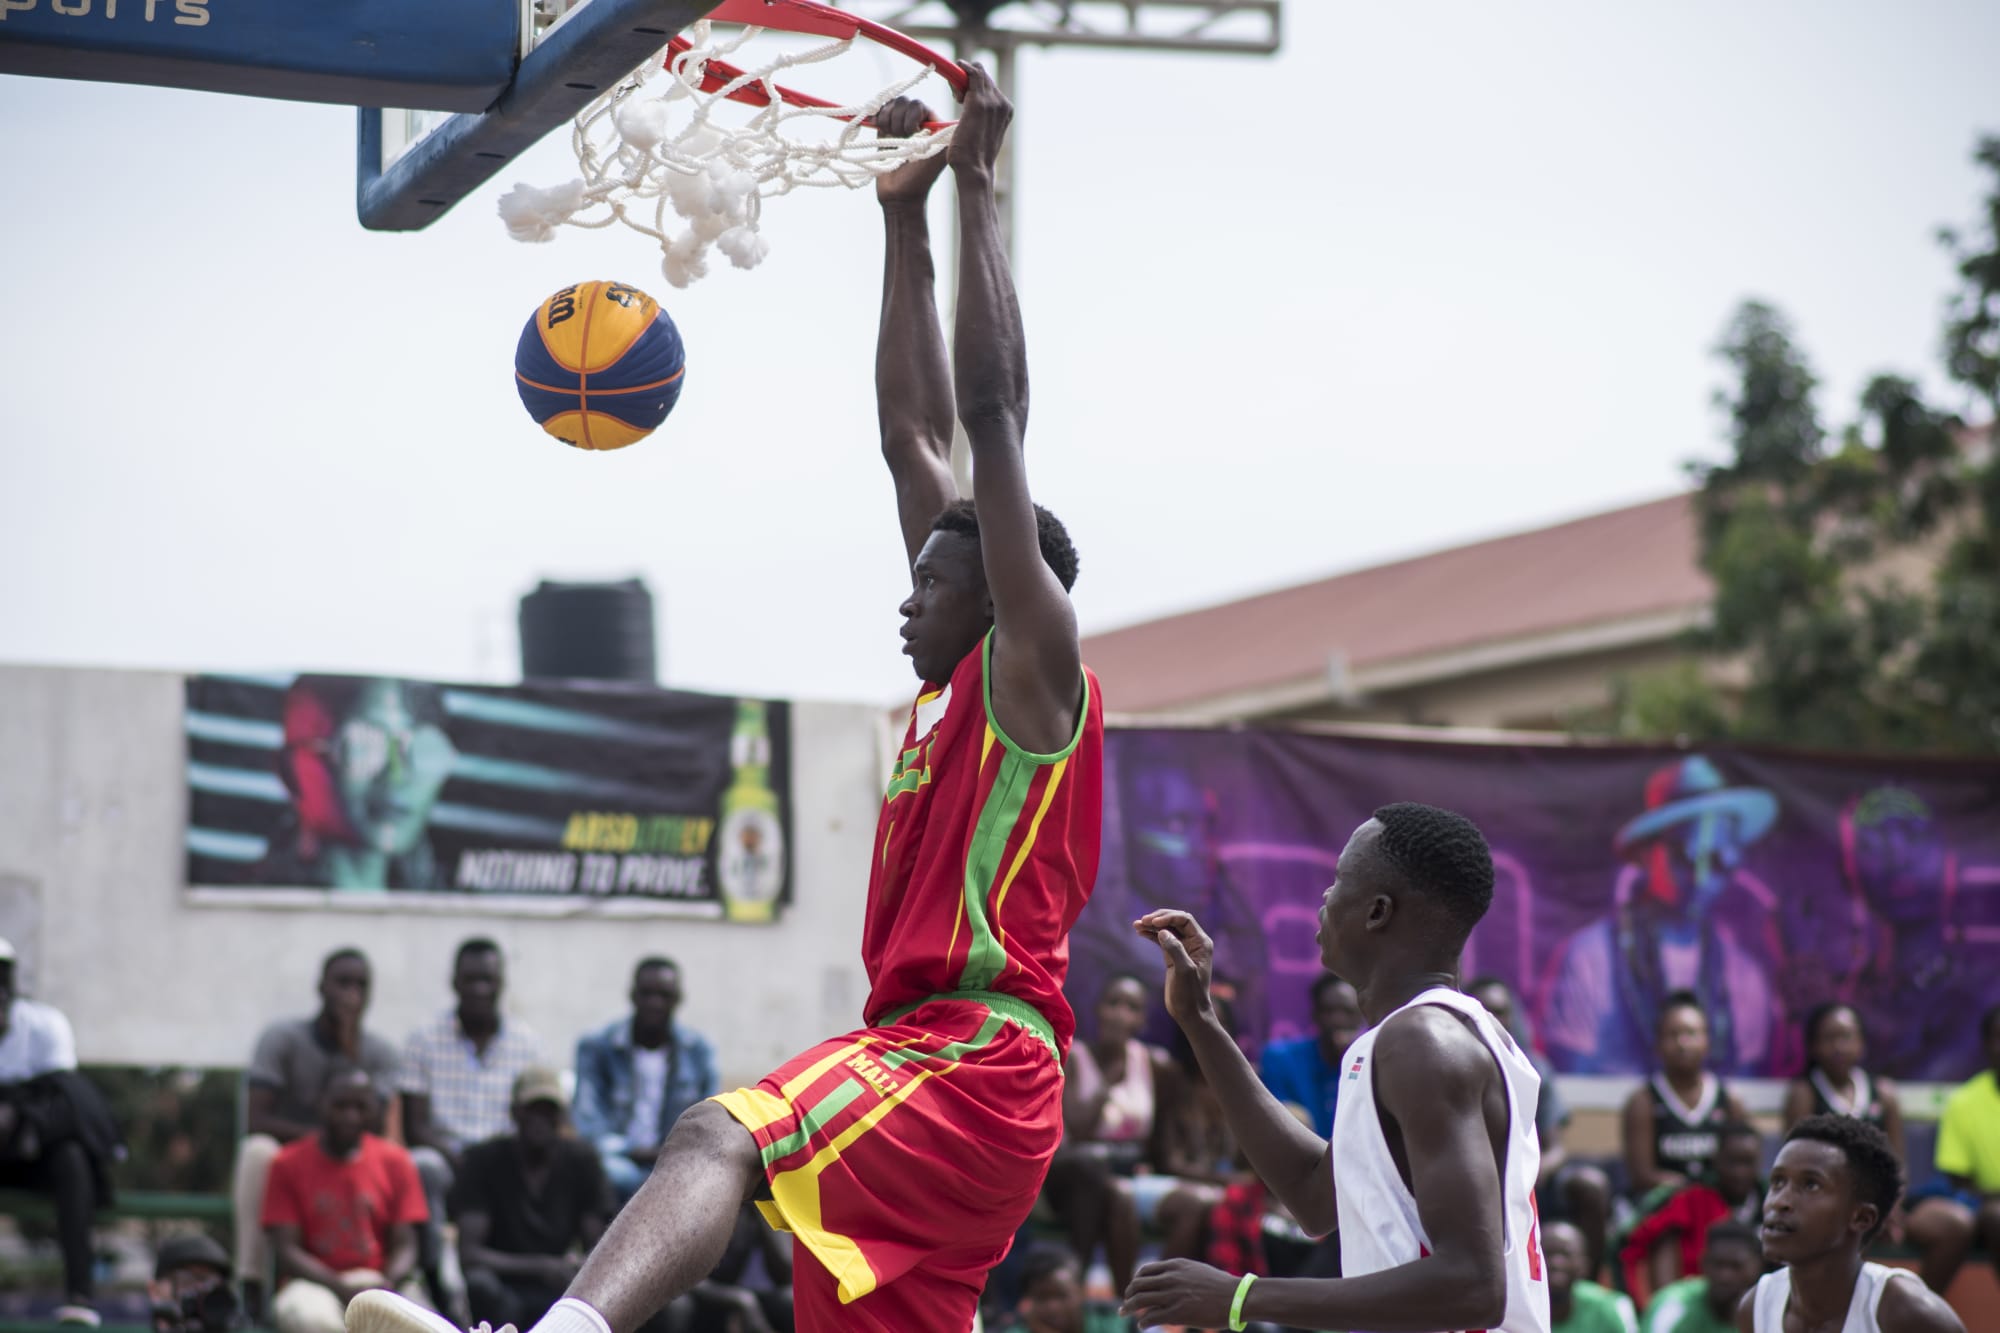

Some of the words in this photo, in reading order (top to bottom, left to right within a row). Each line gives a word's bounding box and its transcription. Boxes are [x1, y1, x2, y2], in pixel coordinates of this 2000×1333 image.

[456, 849, 577, 891] NOTHING
[580, 852, 617, 892] TO
[846, 1052, 899, 1098] MALI
